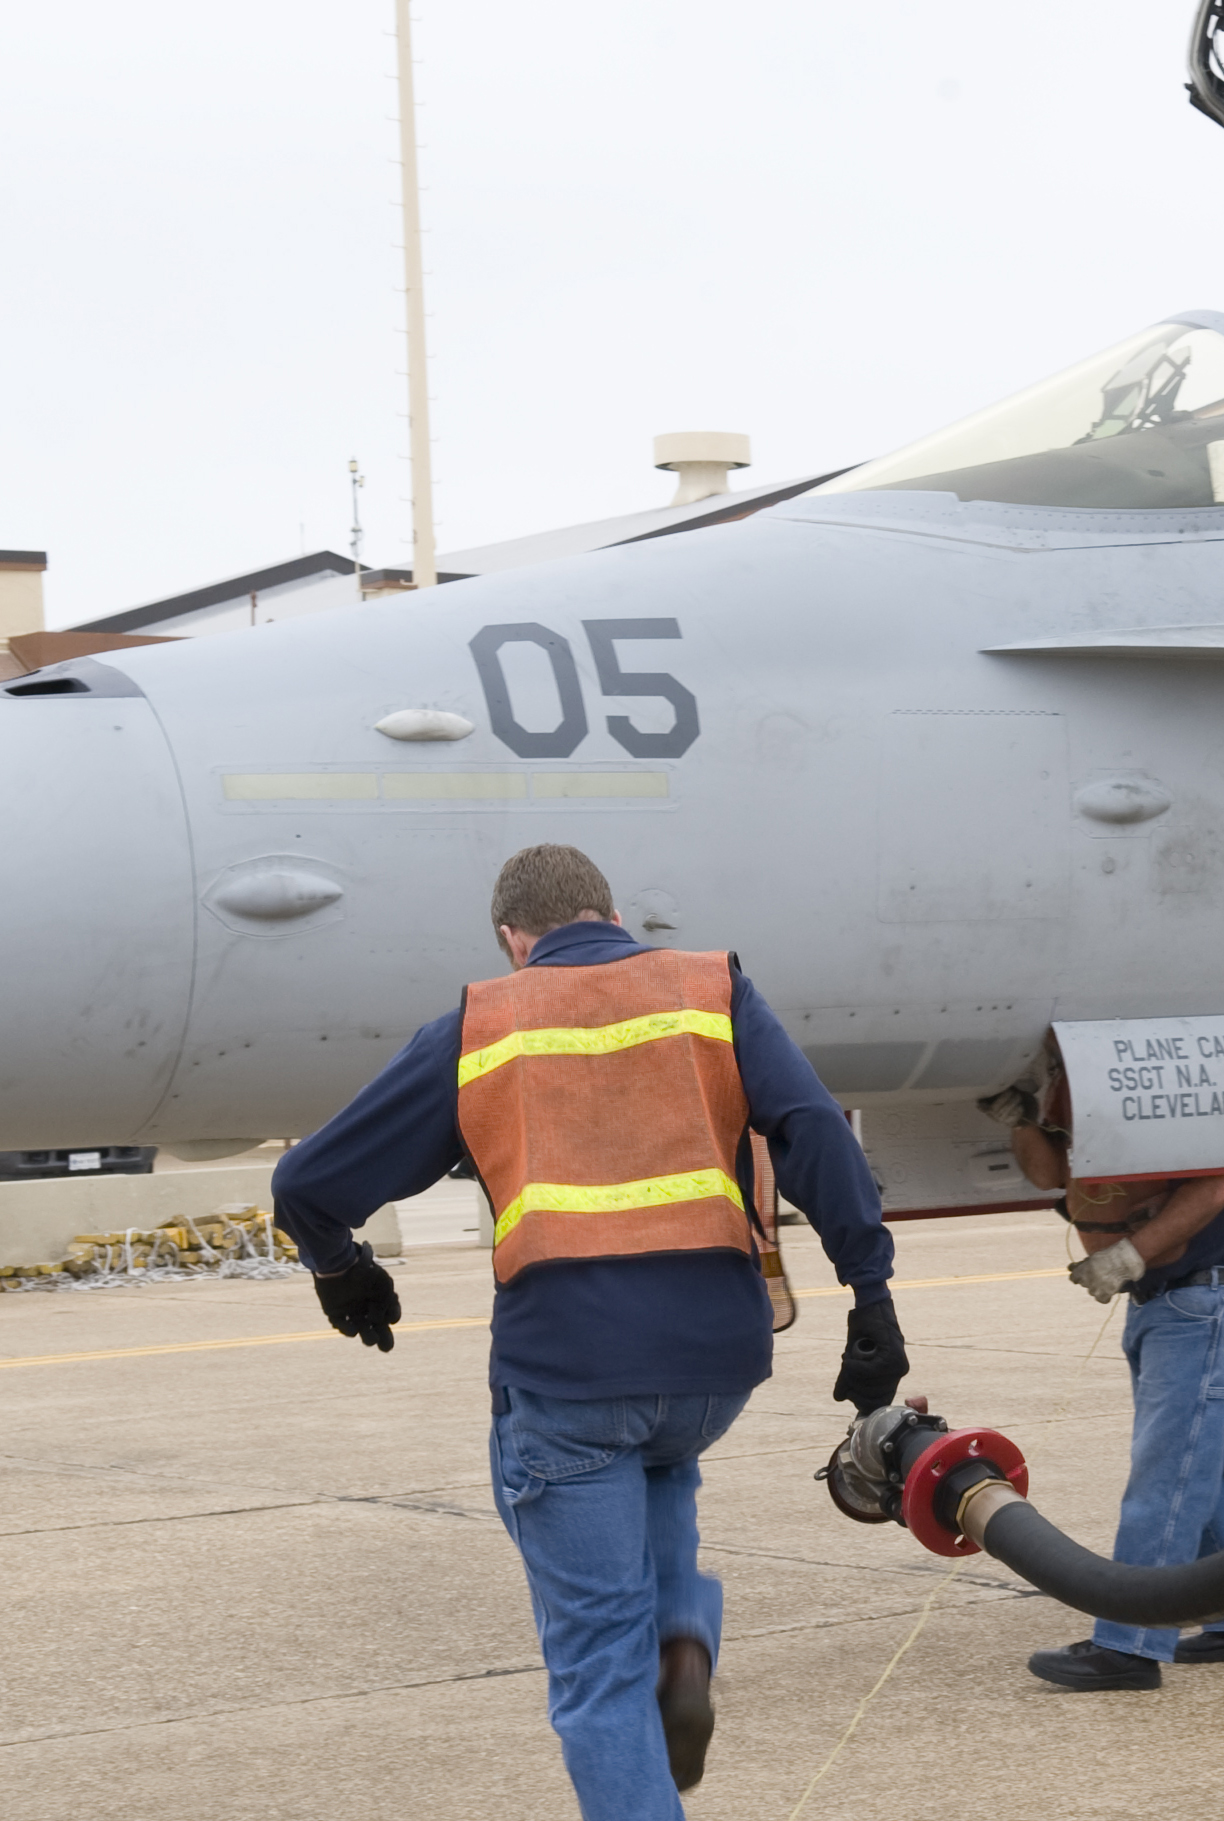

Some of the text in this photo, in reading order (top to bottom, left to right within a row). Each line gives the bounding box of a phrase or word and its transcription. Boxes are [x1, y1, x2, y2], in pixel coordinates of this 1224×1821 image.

[468, 617, 701, 759] 05
[1113, 1037, 1188, 1062] PLANE
[1108, 1065, 1165, 1092] SSGT
[1176, 1062, 1217, 1088] N.A.
